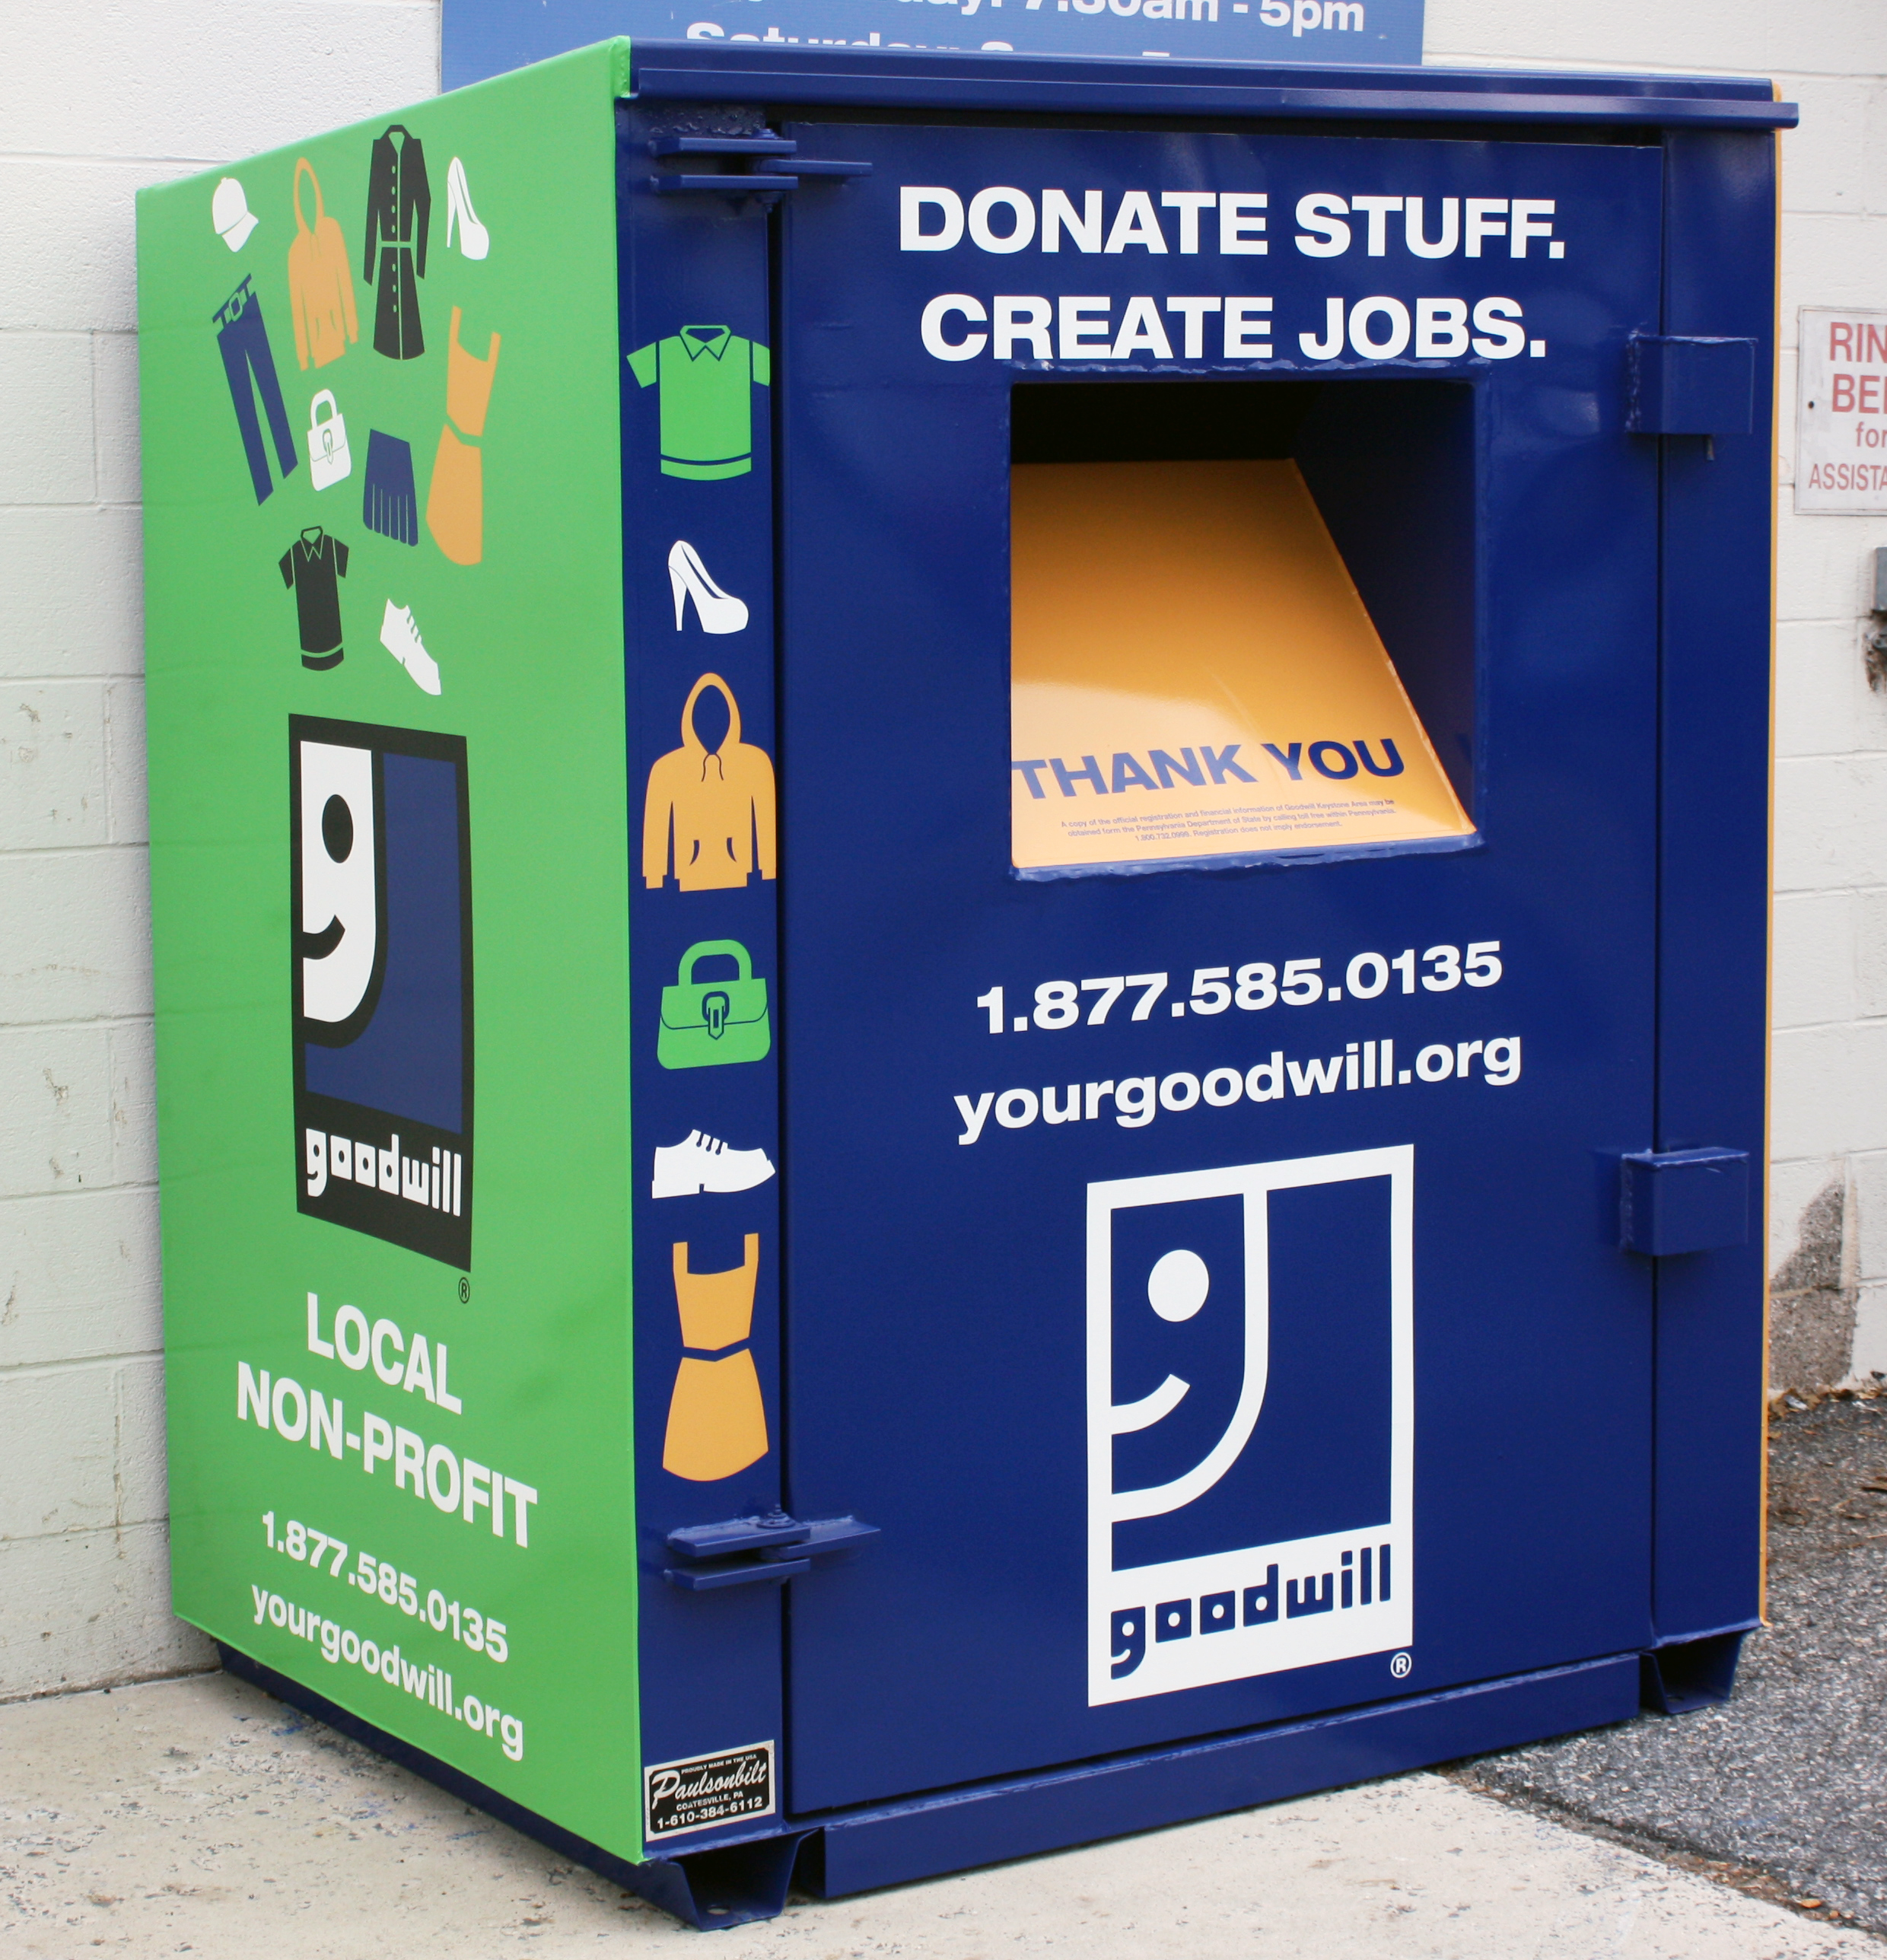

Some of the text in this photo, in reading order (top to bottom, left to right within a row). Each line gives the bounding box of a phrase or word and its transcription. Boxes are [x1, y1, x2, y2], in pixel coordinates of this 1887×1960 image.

[1260, 0, 1364, 37] 5pm
[901, 186, 1565, 259] DONATE STUFF.
[921, 294, 1546, 361] CREATE JOBS.
[1832, 374, 1887, 414] BE
[1012, 738, 1405, 800] THANK YOU
[1068, 820, 1087, 829] copy
[1112, 816, 1138, 824] official
[1140, 812, 1183, 822] registration
[1200, 808, 1231, 817] financial
[1233, 806, 1274, 814] information
[1284, 802, 1316, 811] Goodwill
[1316, 802, 1350, 810] Keystone
[1068, 828, 1101, 837] obtained
[1136, 822, 1185, 832] Pennsylvania
[1187, 818, 1231, 828] Department
[1273, 813, 1297, 822] calling
[1193, 826, 1239, 837] Registration
[1274, 823, 1293, 832] imply
[978, 940, 1503, 1034] 1.877.585.0135
[954, 1036, 1521, 1145] yourgoodwill.org
[306, 1128, 462, 1217] goodwill
[307, 1292, 463, 1415] LOCAL
[237, 1361, 538, 1548] NON-PROFIT
[263, 1511, 509, 1663] 1.877.585.0135
[1111, 1543, 1392, 1680] goodwill
[252, 1585, 523, 1761] yourgoodwill.org
[651, 1760, 768, 1810] Paulsonbilt
[681, 1764, 708, 1775] PROUDLY
[708, 1760, 724, 1770] MADE
[733, 1756, 745, 1764] THE
[657, 1796, 763, 1829] 1-610-384-6112
[676, 1790, 743, 1812] COATESVILLE, PA
